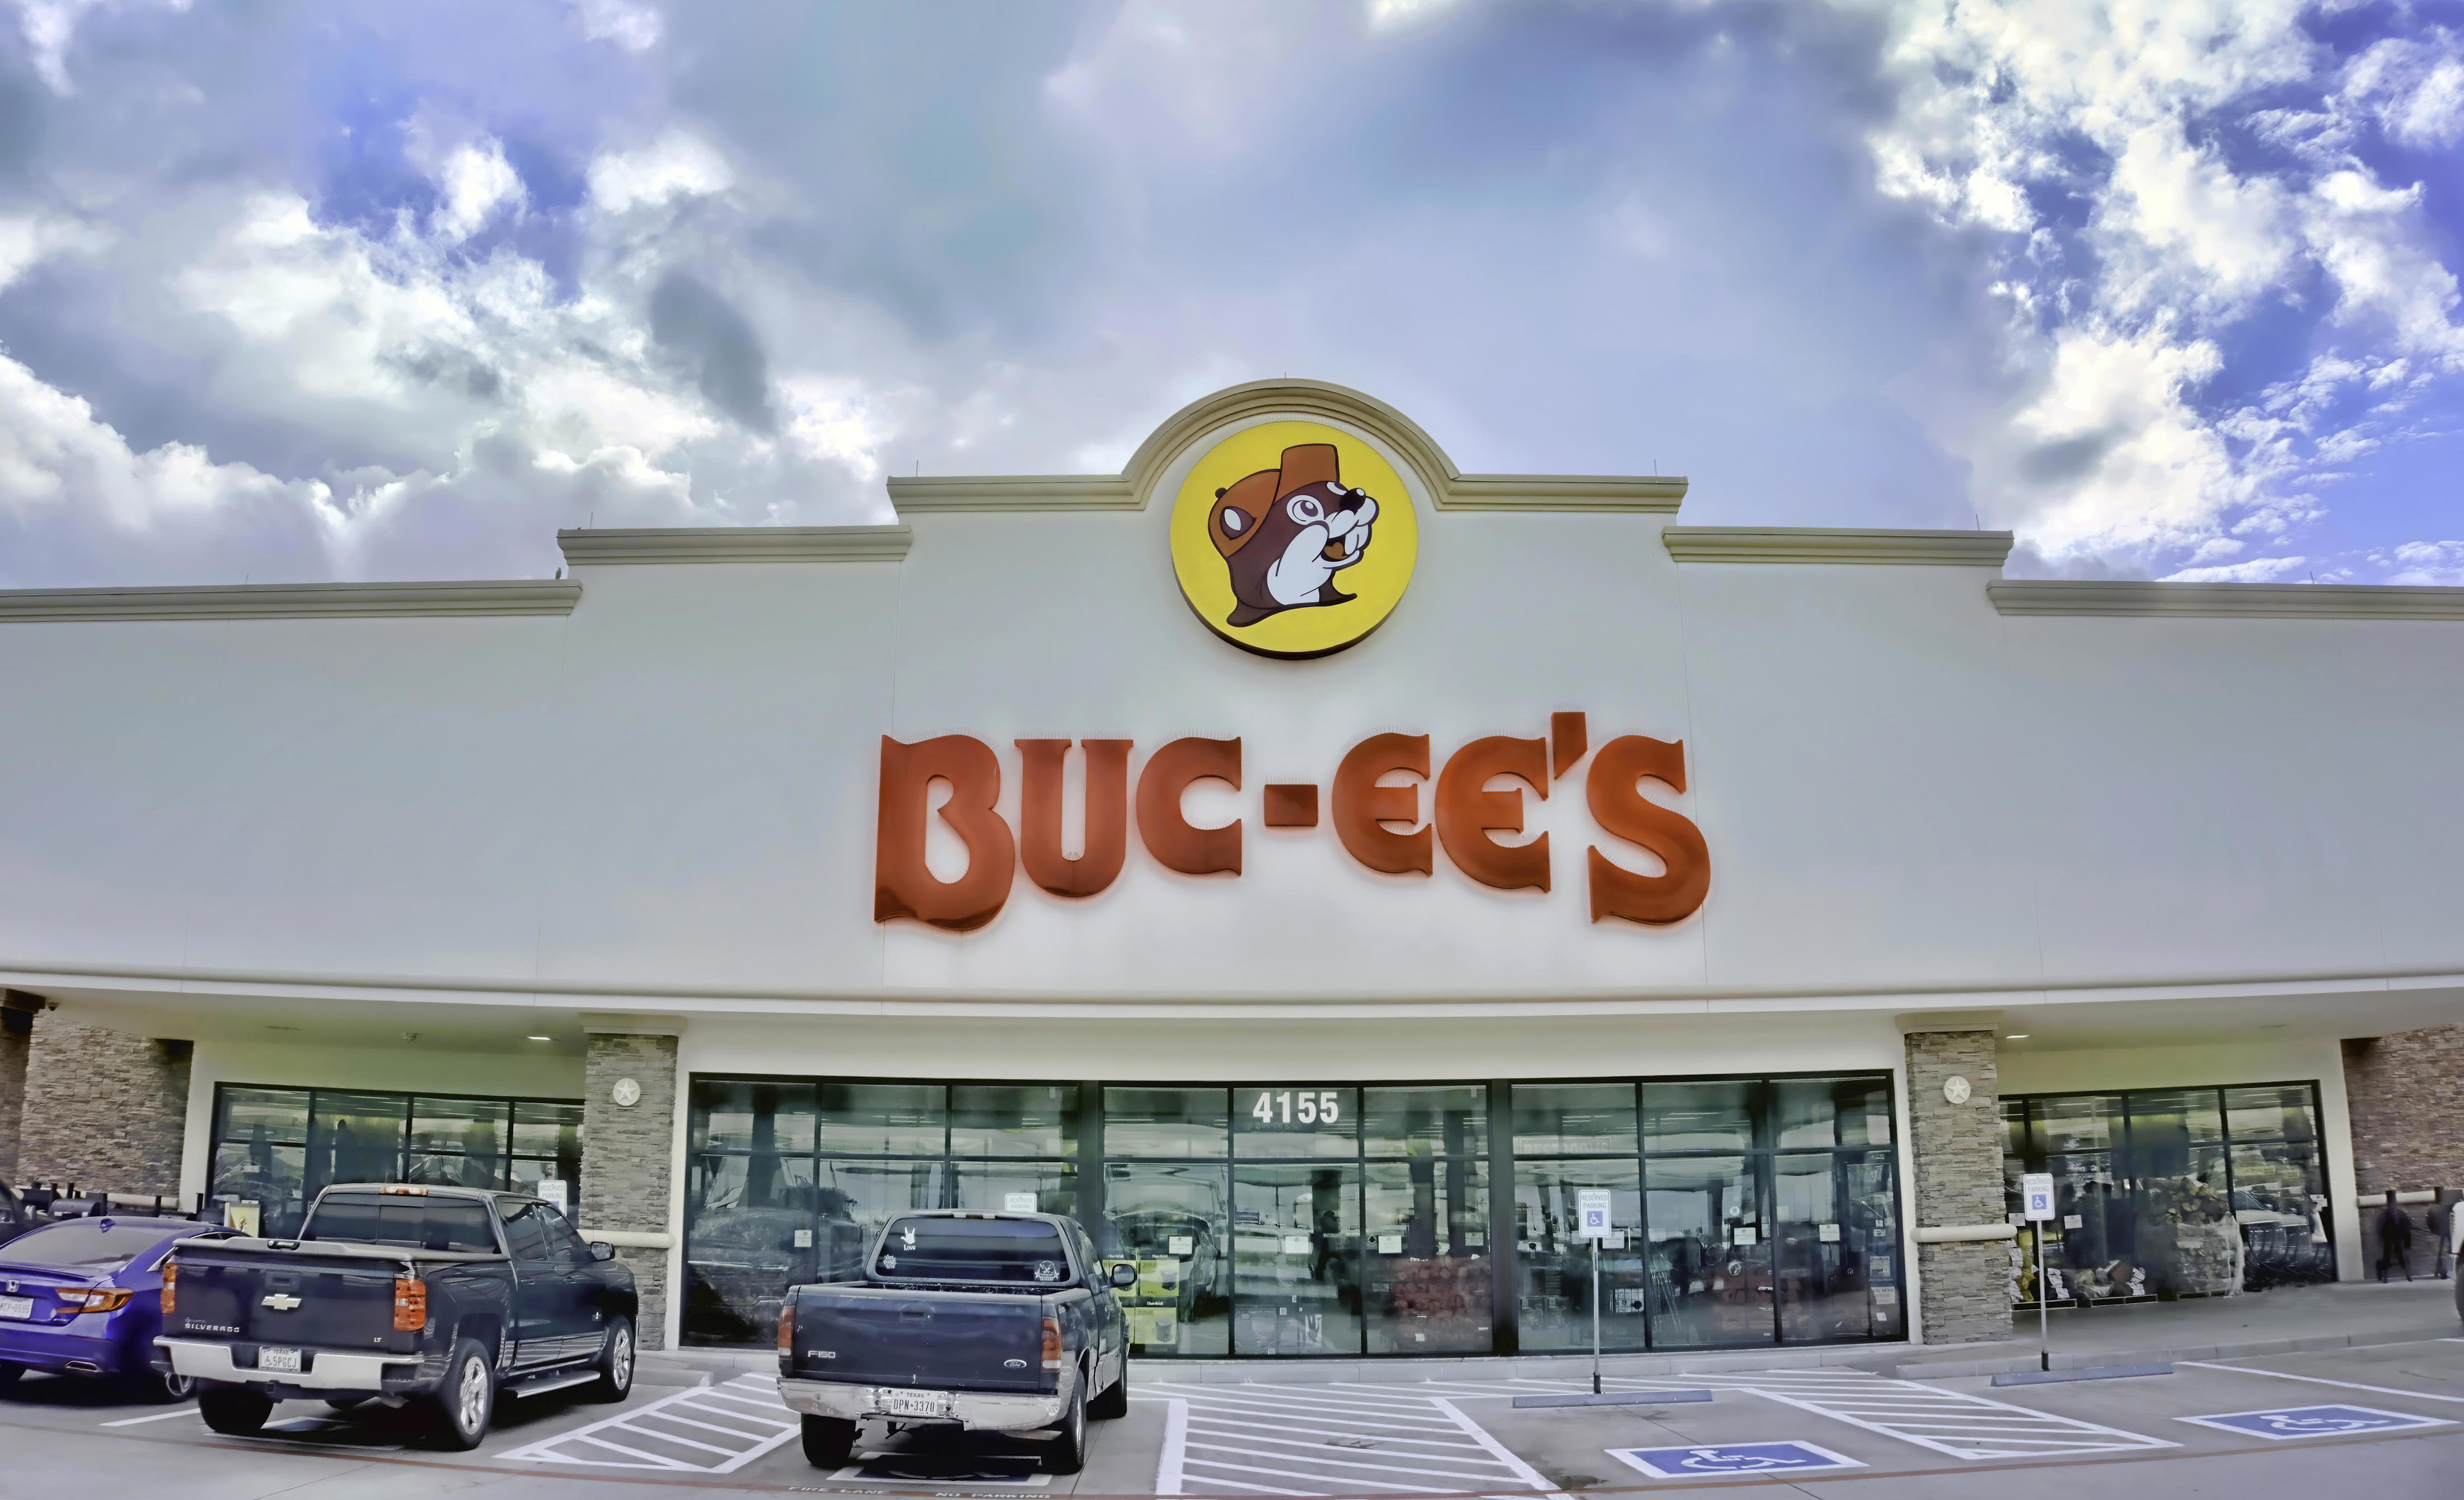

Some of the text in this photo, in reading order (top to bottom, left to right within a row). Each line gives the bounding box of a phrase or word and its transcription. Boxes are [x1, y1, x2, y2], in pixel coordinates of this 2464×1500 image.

[874, 711, 1710, 931] BUC-EE'S
[1253, 1091, 1339, 1124] 4155
[185, 1323, 240, 1333] SILVERADO
